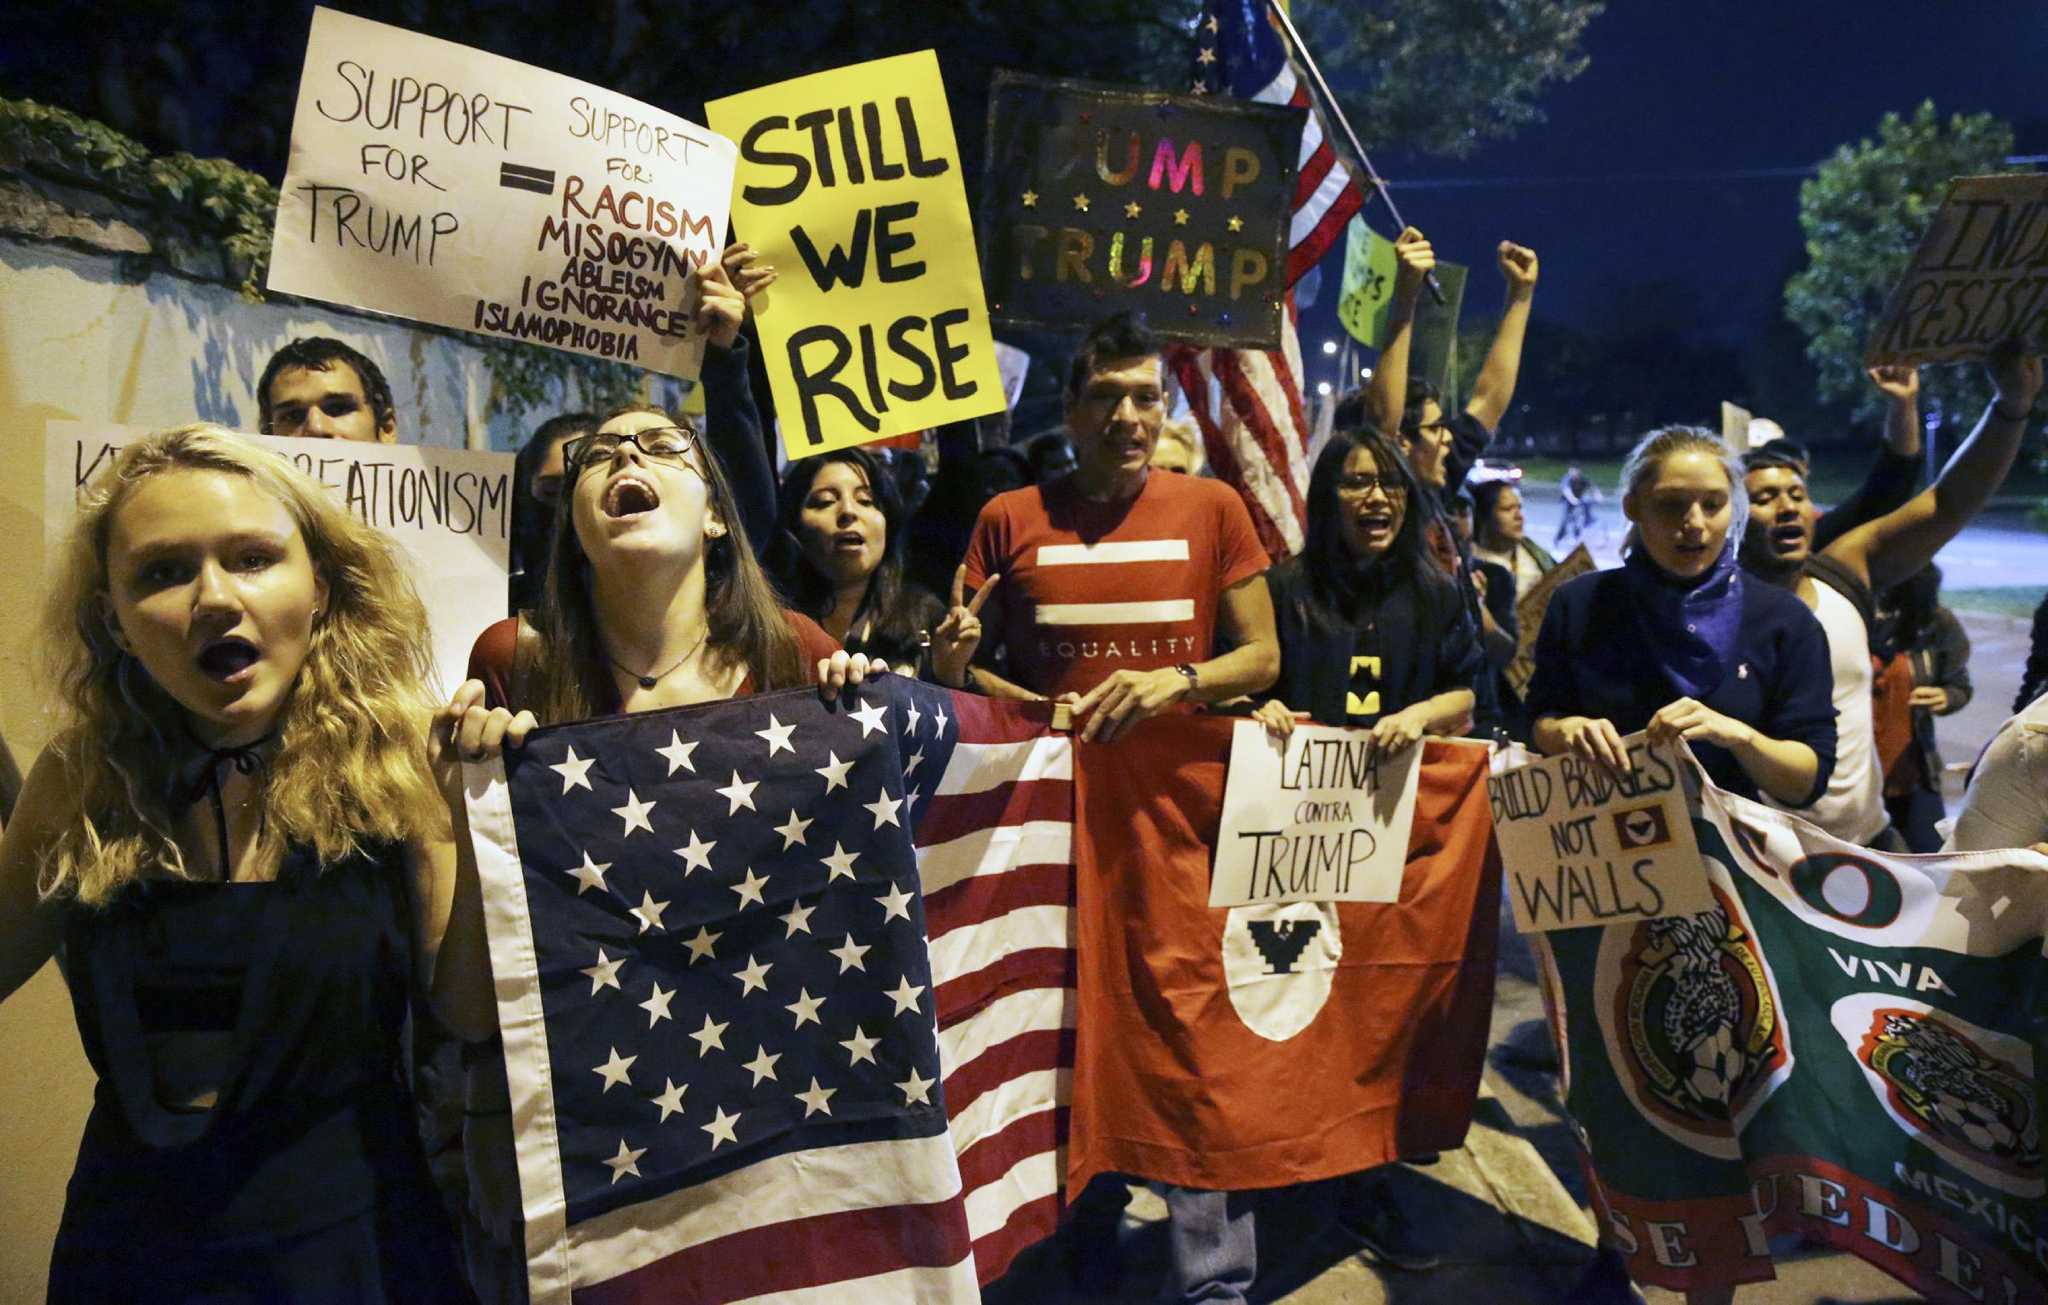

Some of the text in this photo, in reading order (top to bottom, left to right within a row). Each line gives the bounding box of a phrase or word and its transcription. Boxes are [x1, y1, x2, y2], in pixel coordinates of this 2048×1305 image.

[316, 61, 532, 150] SUPPORT
[568, 96, 709, 167] SUPPORT
[362, 144, 446, 192] FOR
[607, 158, 653, 184] FOR:
[740, 96, 949, 206] STILL
[297, 184, 458, 266] TRUMP
[562, 175, 715, 249] RACISM
[538, 215, 707, 279] MISOGYNY
[561, 256, 664, 301] ABLEISM
[789, 201, 926, 293] WE
[1013, 224, 1267, 299] TRUMP
[474, 300, 640, 360] ISLAMOPHOBIA
[521, 275, 688, 338] IGNORANCE
[786, 308, 977, 445] RISE
[1039, 636, 1196, 659] EQUALITY
[1281, 739, 1379, 790] LATINA
[1486, 767, 1552, 824] BUILD
[1294, 801, 1352, 824] CONTRA
[1551, 815, 1597, 859] NOT
[1239, 828, 1375, 899] TRUMP
[1515, 859, 1664, 923] WALLS
[1827, 946, 1957, 997] VIVA
